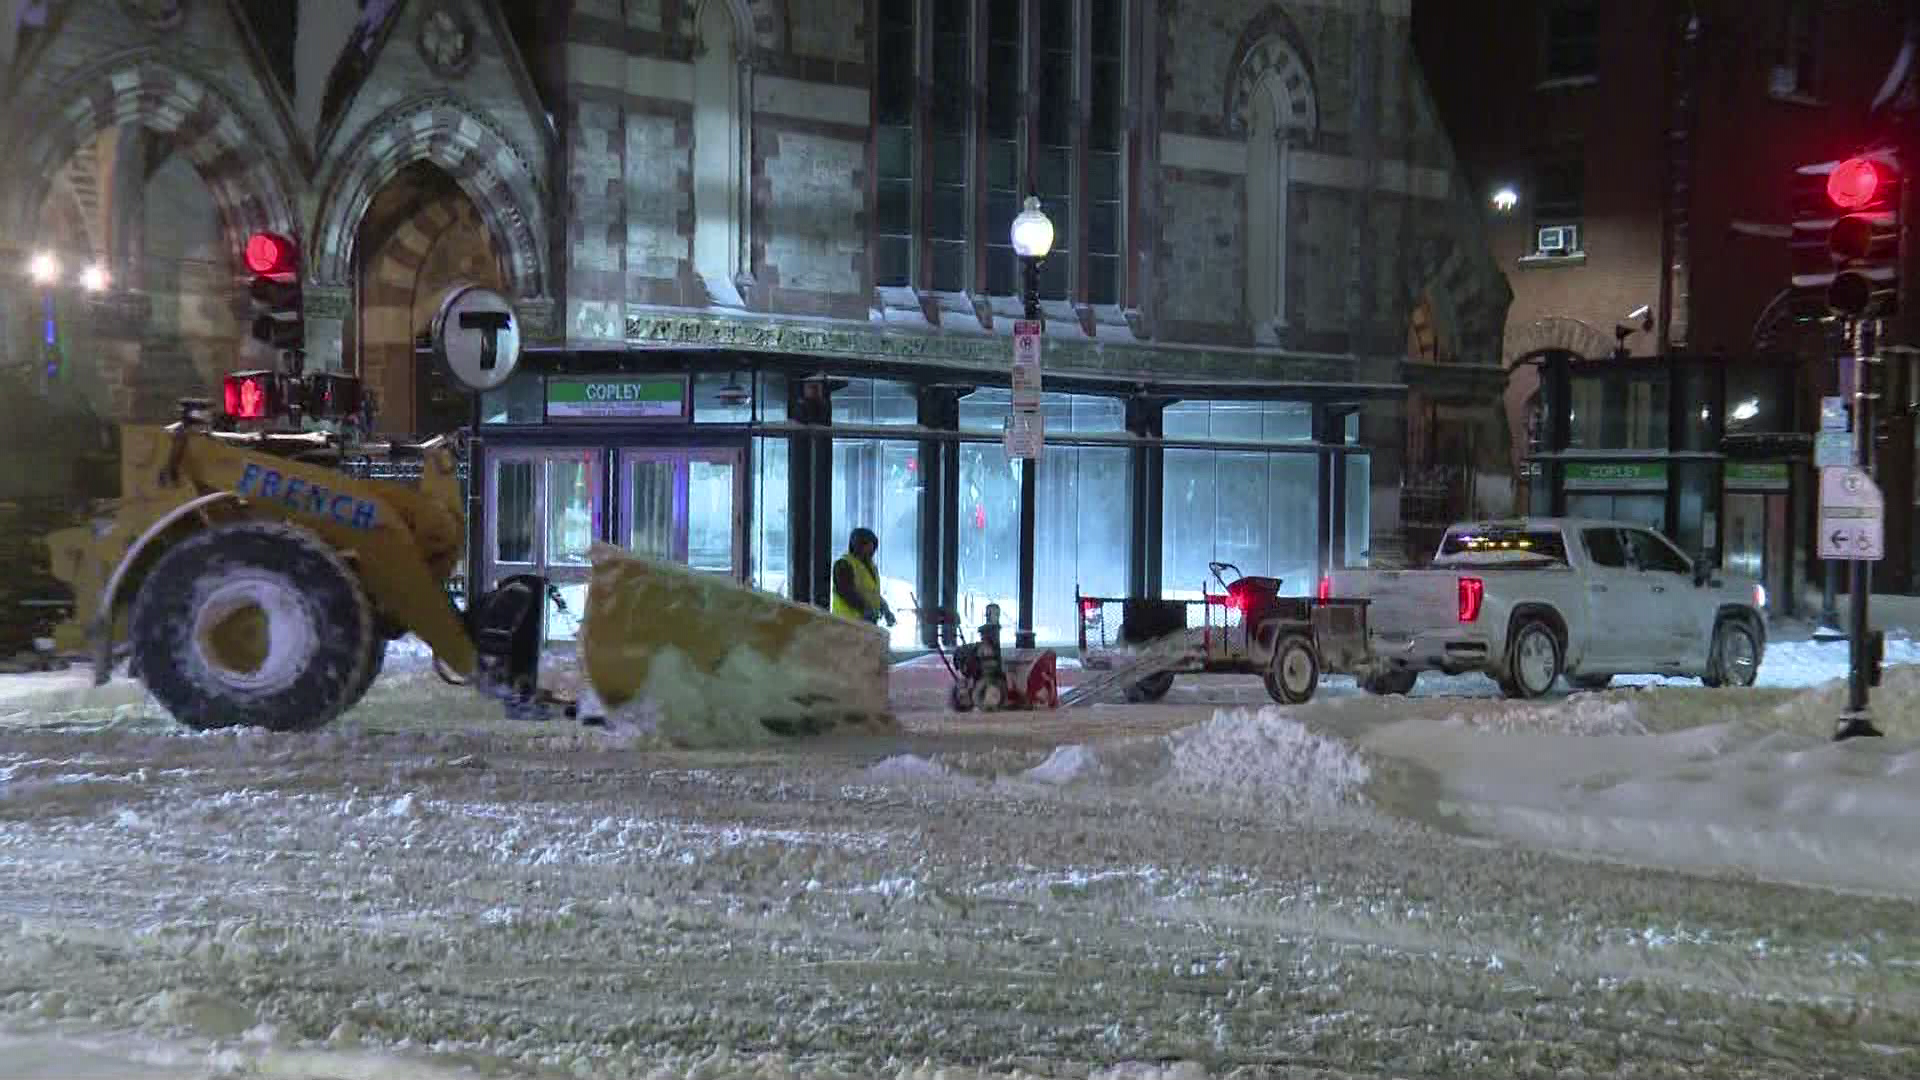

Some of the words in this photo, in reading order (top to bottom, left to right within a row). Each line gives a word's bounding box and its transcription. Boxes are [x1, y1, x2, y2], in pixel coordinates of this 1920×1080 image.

[459, 312, 512, 370] T
[585, 383, 641, 400] COPLEY
[239, 463, 376, 529] FRENCH
